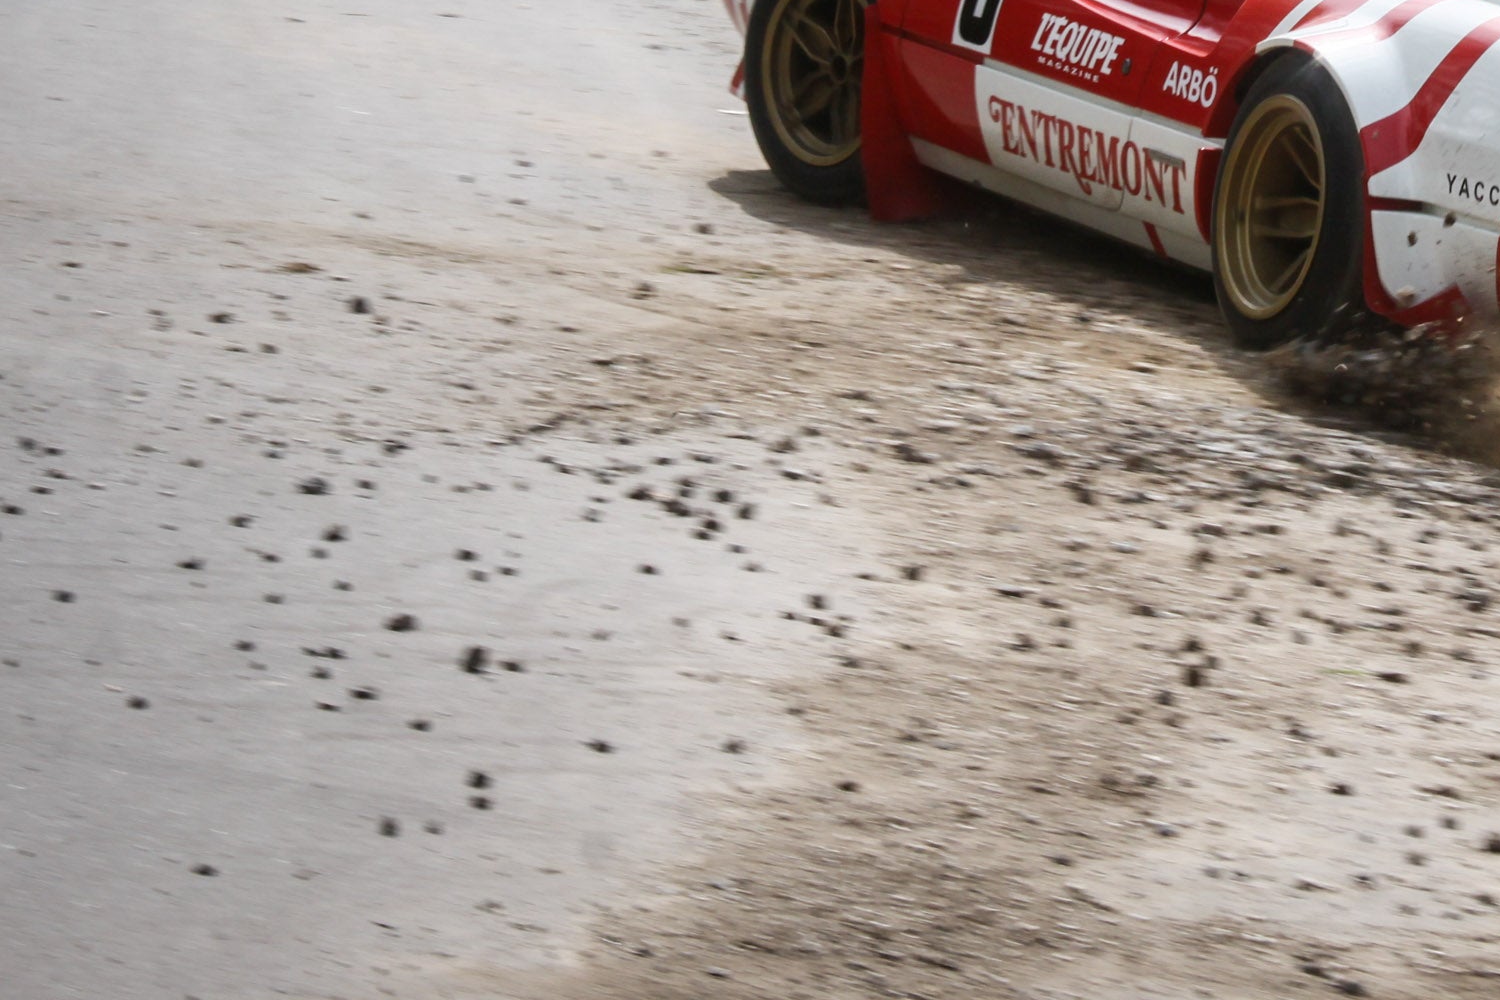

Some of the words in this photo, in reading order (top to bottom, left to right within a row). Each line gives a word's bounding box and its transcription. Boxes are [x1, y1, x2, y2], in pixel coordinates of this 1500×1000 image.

[1038, 56, 1100, 83] MAGAZINE
[1163, 60, 1217, 108] ARBÖ
[989, 95, 1186, 214] ENTREMONT
